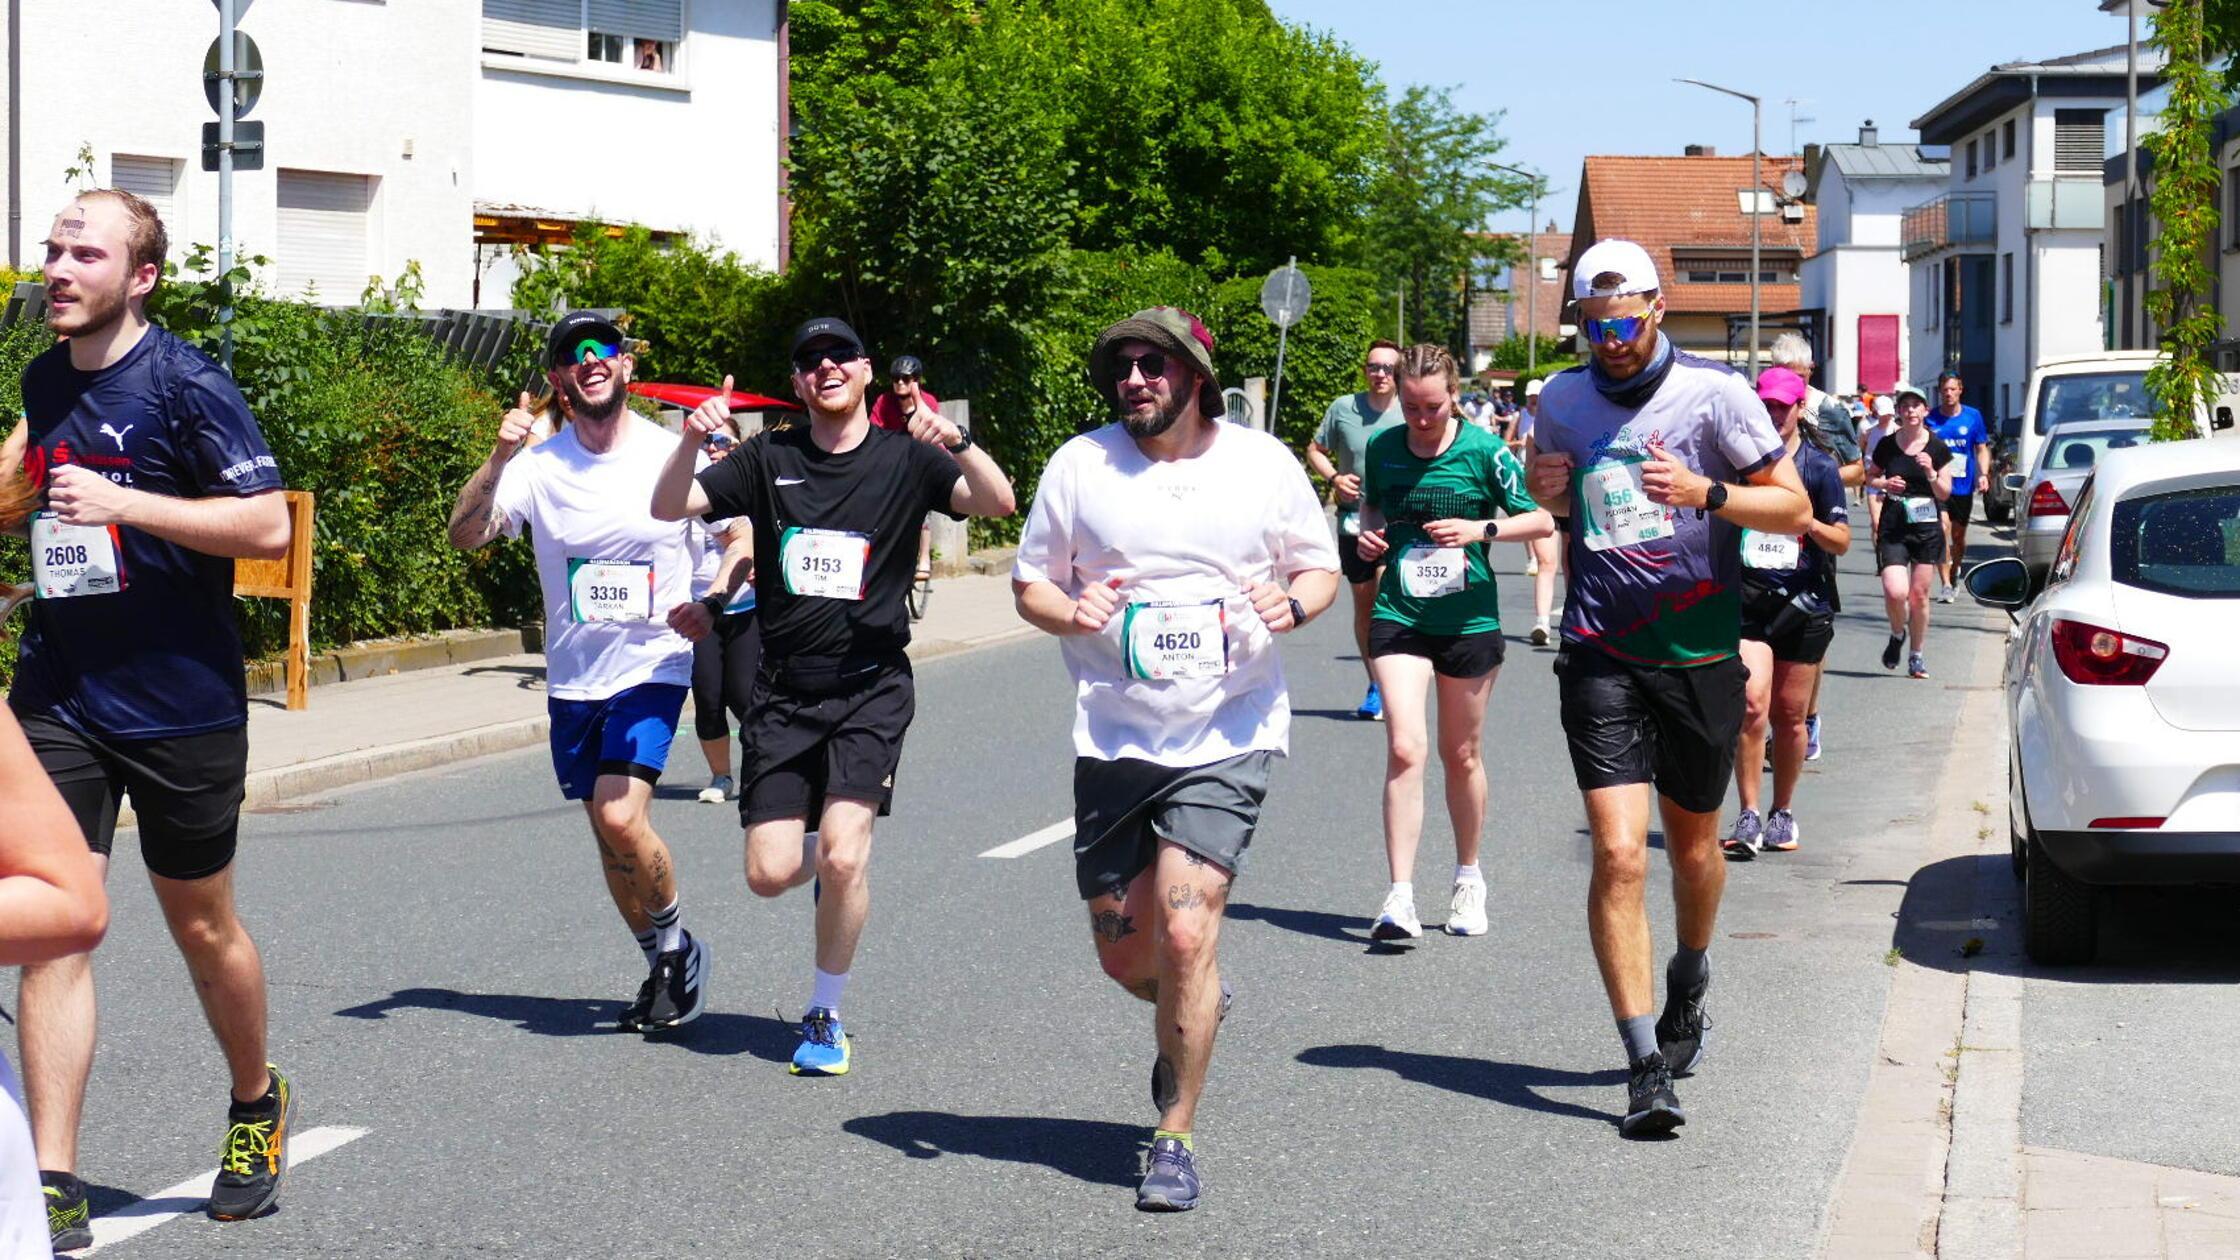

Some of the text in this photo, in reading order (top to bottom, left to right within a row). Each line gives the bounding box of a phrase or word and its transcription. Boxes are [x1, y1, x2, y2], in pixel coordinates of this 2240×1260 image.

[1604, 489, 1633, 507] 456
[1638, 526, 1659, 539] 456
[1758, 543, 1785, 554] 4842
[45, 545, 87, 566] 2608
[802, 556, 842, 573] 3153
[49, 567, 87, 578] THOMAS
[814, 574, 828, 582] TIM
[1416, 566, 1448, 578] 3532
[590, 586, 628, 601] 3336
[1153, 632, 1201, 650] 4620
[1161, 653, 1195, 662] ANTON
